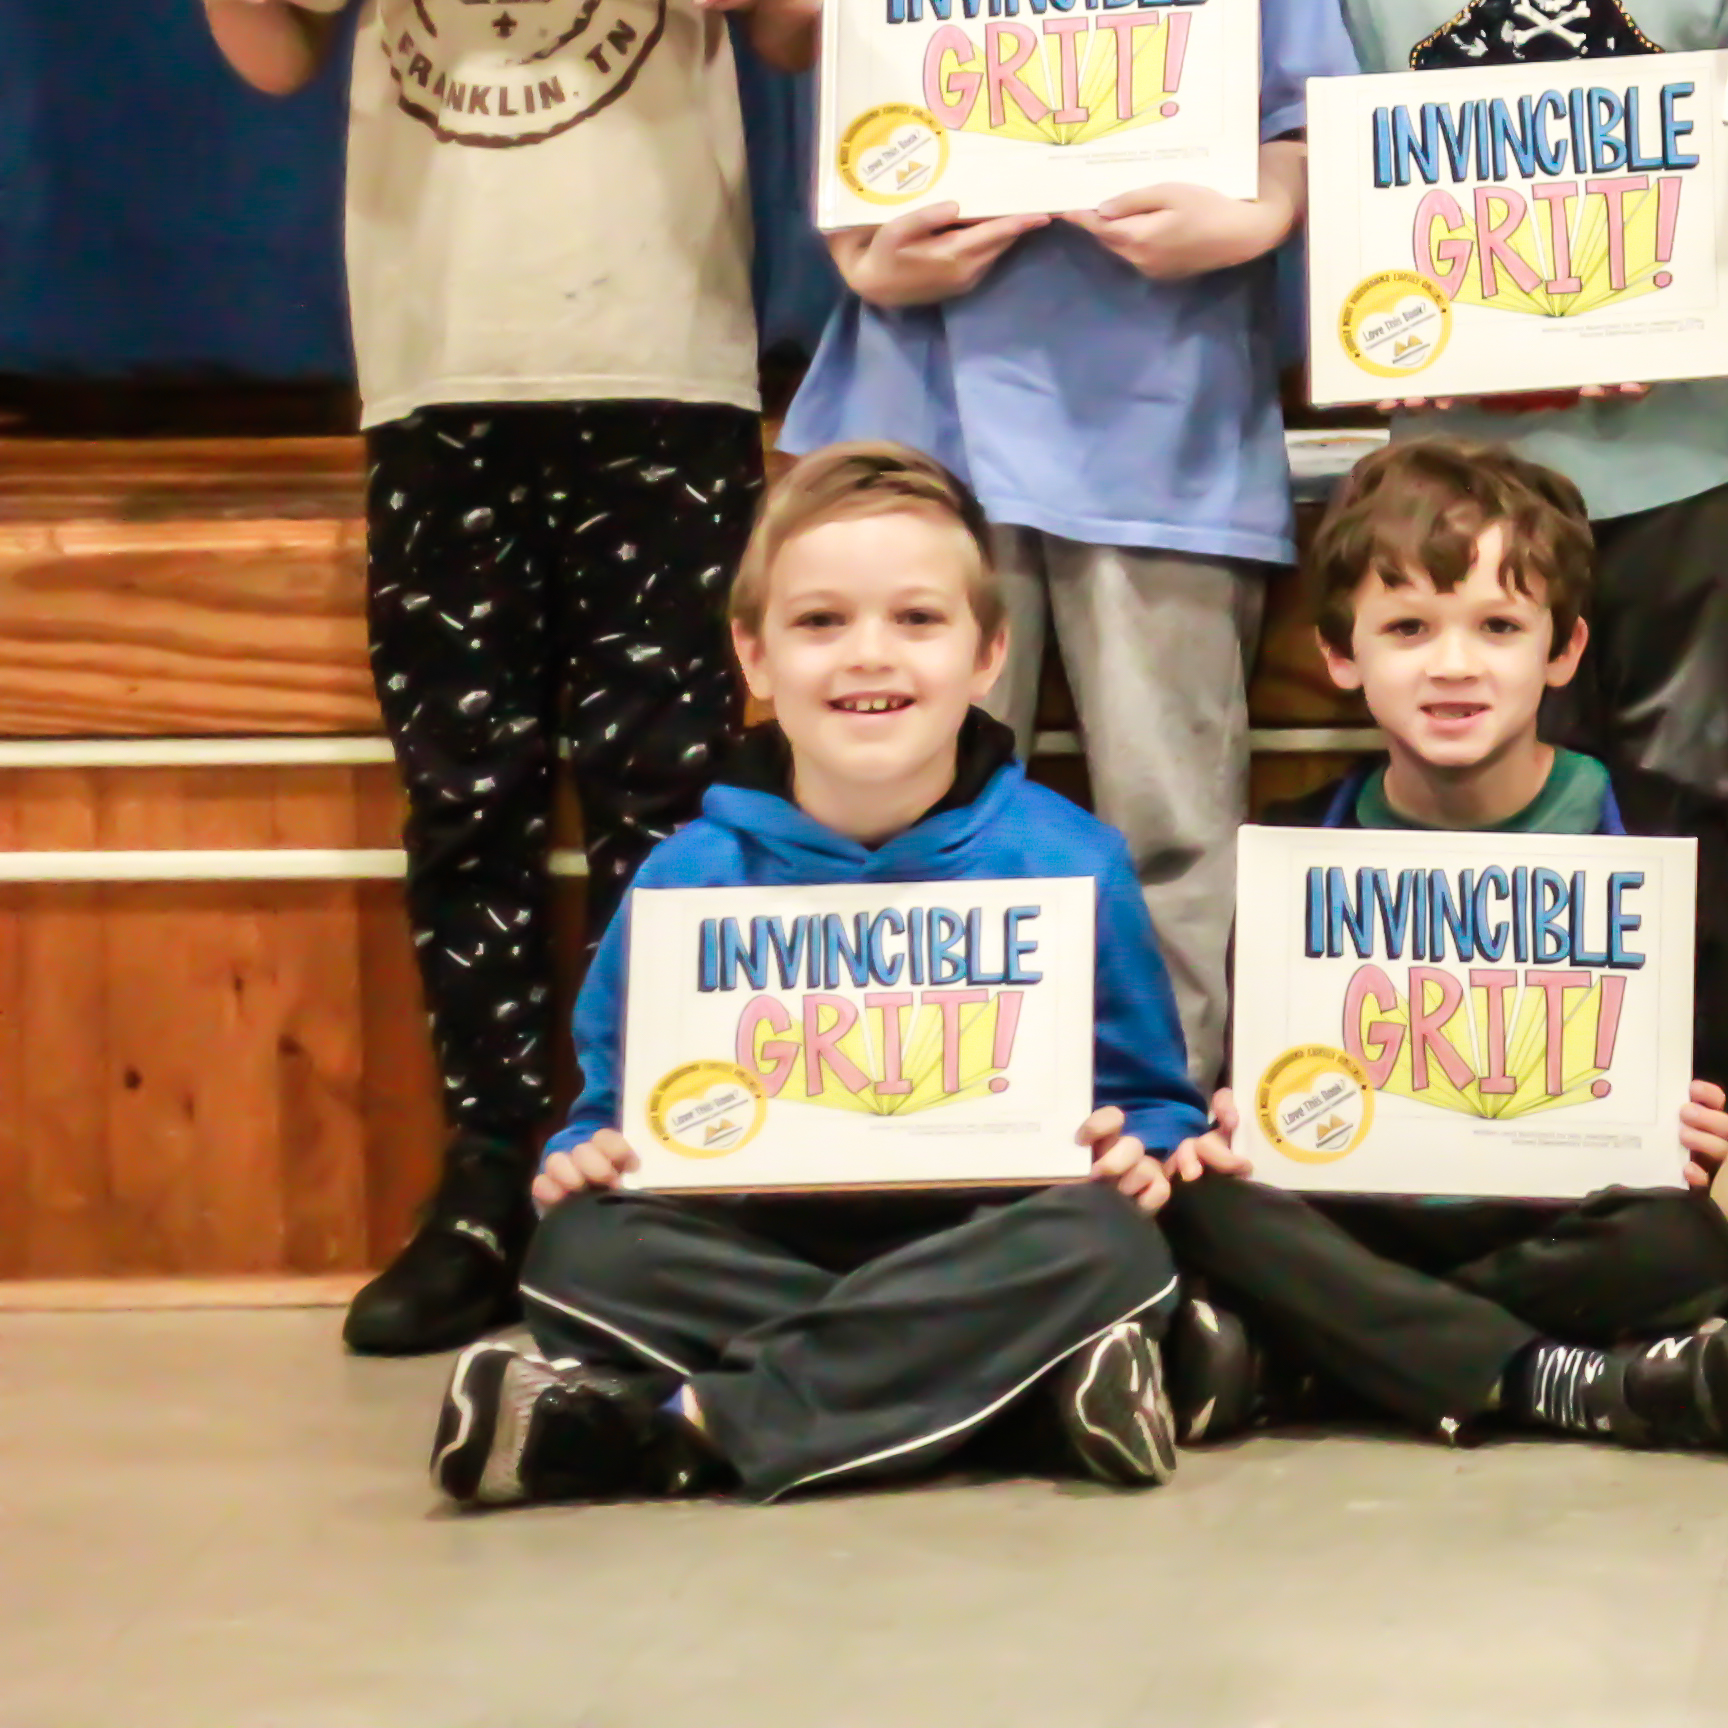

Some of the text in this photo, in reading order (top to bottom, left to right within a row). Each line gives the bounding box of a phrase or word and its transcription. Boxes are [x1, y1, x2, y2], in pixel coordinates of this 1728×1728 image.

[585, 17, 638, 74] TN
[928, 12, 1186, 129] GRIT!
[1373, 83, 1698, 187] INVINCIBLE
[1417, 176, 1682, 297] GRIT!
[700, 909, 1040, 991] INVINCIBLE
[1306, 869, 1642, 969] INVINCIBLE
[736, 990, 1024, 1095] GRIT!
[1342, 965, 1626, 1098] GRIT!
